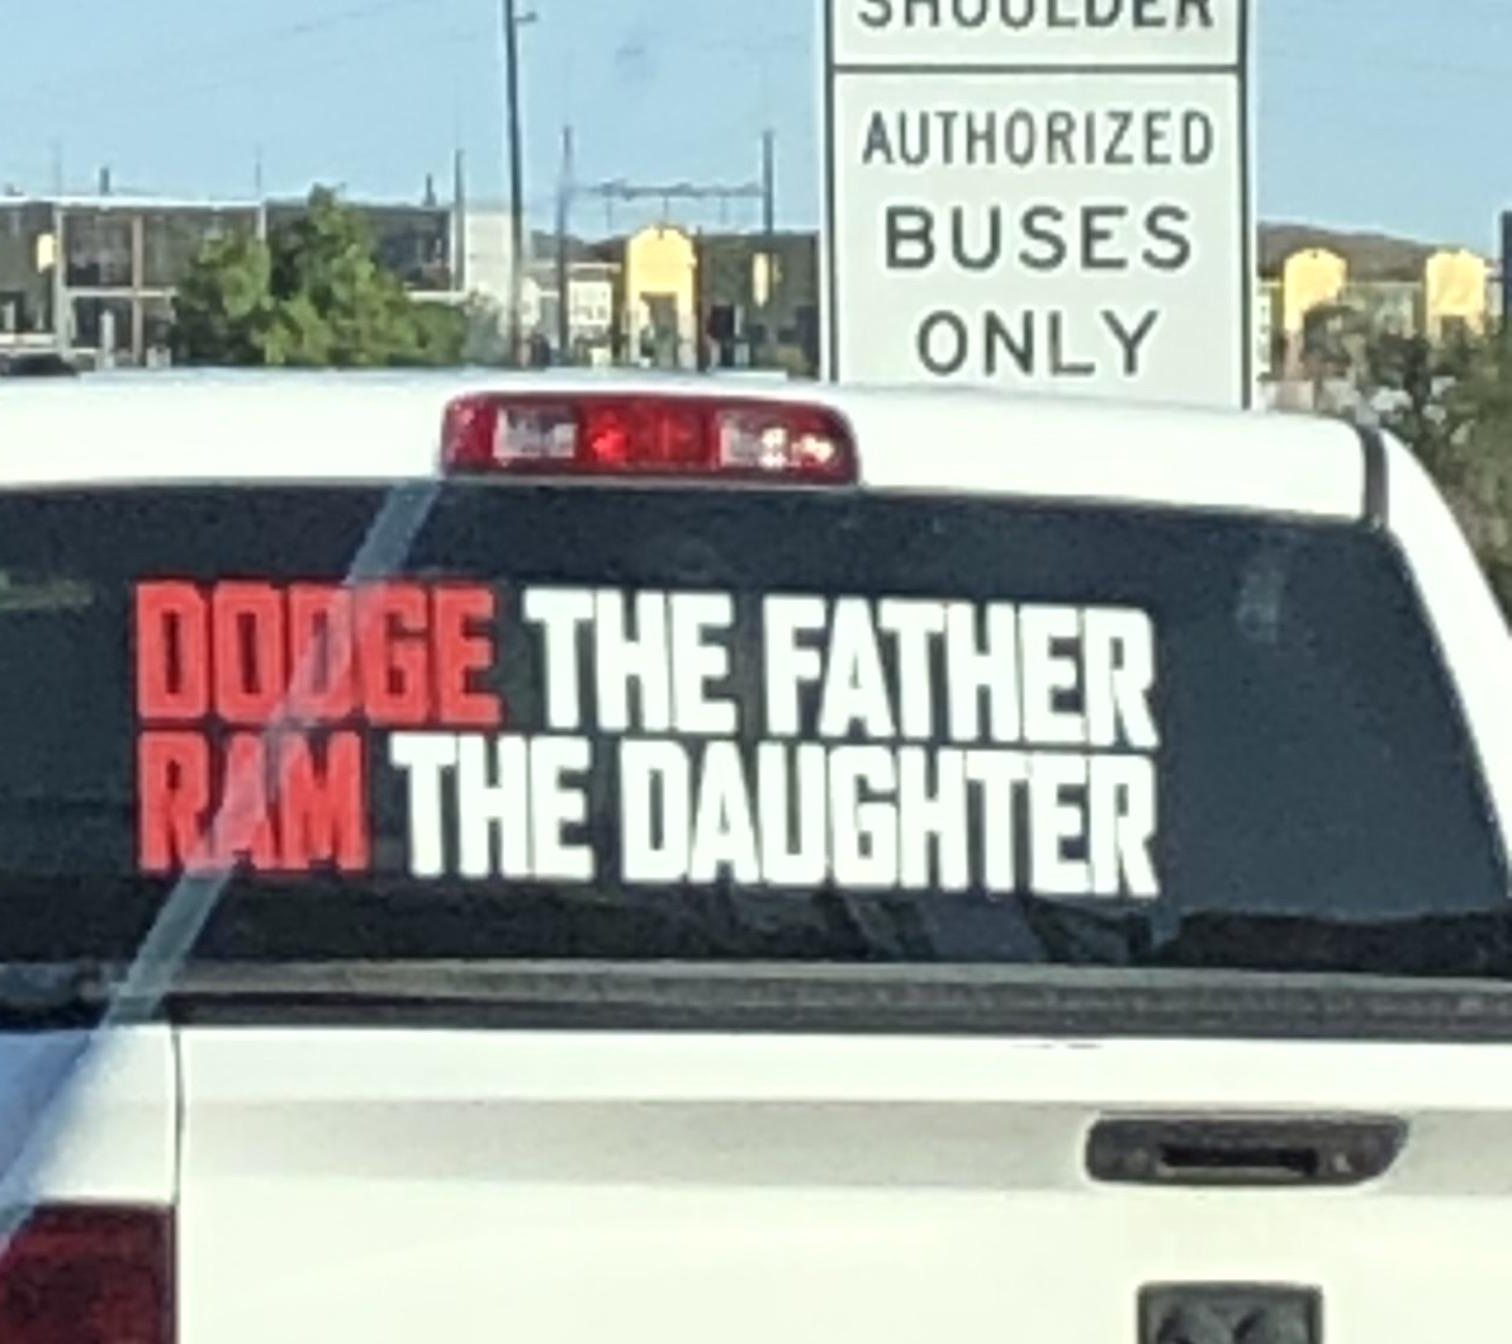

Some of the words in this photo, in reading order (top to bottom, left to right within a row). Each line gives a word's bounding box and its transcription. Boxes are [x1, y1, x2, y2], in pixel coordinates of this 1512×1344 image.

[861, 110, 1214, 166] AUTHORIZED
[886, 205, 1191, 270] BUSES
[916, 310, 1158, 376] ONLY
[136, 580, 501, 726] DODGE
[523, 588, 737, 733] THE
[762, 594, 1159, 749] FATHER
[138, 730, 368, 872] RAM
[389, 731, 594, 880] THE
[619, 738, 1159, 897] DAUGHTER
